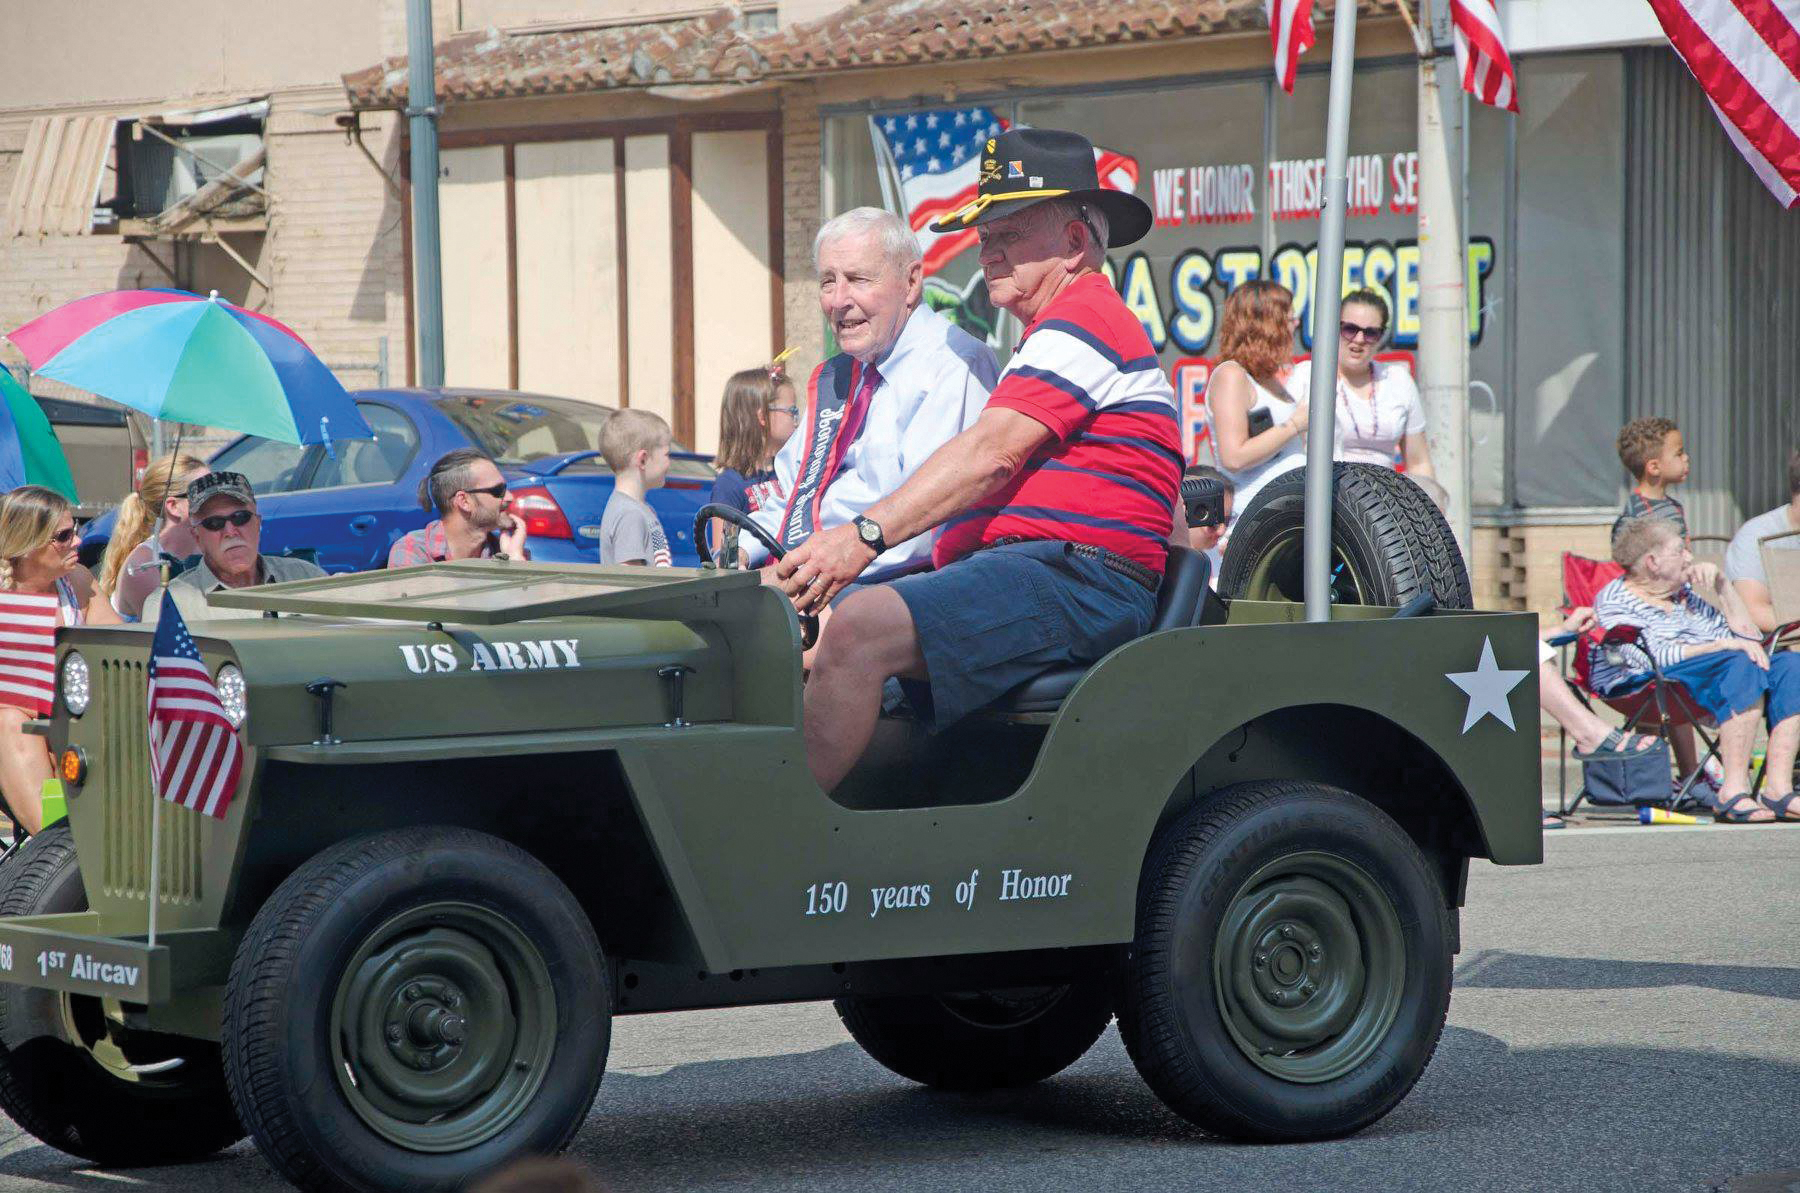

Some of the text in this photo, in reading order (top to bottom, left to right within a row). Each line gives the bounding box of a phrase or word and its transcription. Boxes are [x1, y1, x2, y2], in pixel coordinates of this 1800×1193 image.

[1153, 167, 1186, 223] WE
[1188, 163, 1256, 221] HONOR
[1269, 157, 1326, 217] THOSE
[1390, 151, 1418, 211] SE
[1101, 245, 1263, 355] AST
[399, 639, 581, 674] US ARMY
[805, 868, 1072, 918] 150 years of Honor
[0, 944, 139, 986] 68 1ST Aircav
